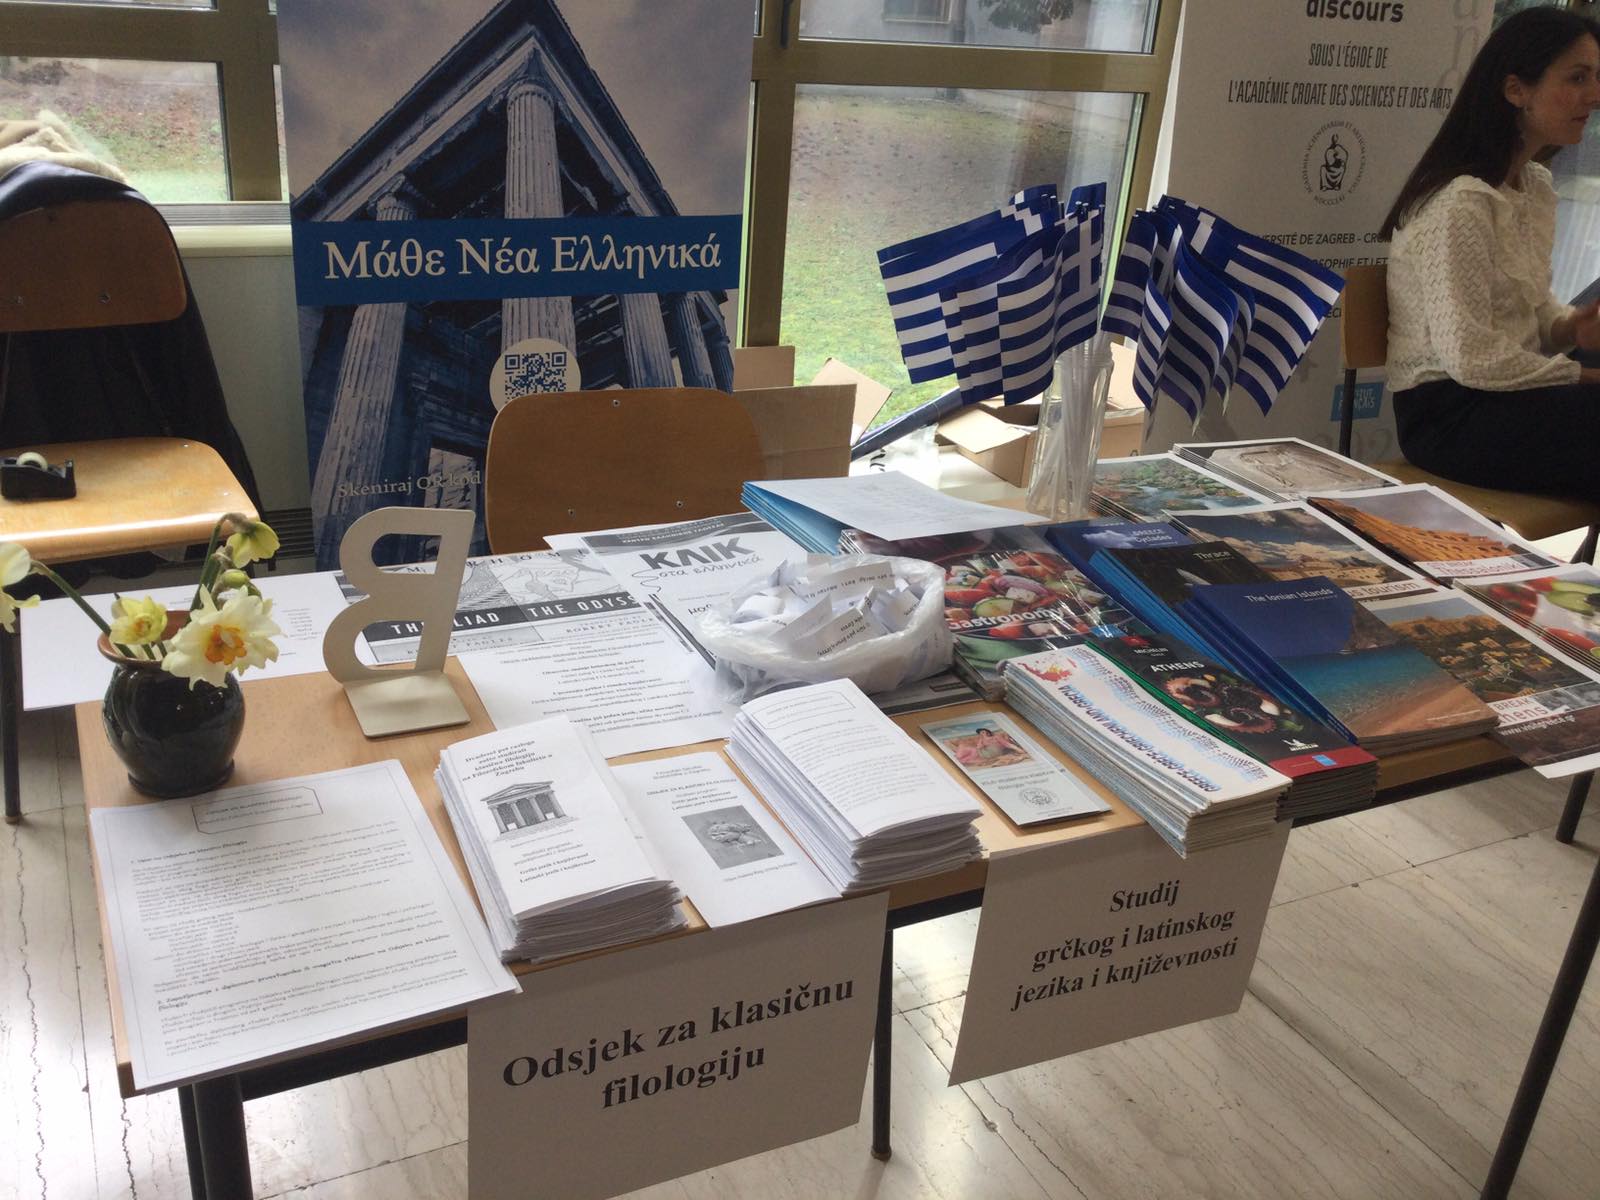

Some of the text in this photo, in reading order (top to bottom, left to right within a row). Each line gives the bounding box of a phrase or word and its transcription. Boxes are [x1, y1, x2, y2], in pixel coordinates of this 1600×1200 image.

[1306, 0, 1404, 22] discours
[1308, 40, 1389, 70] SOUS L'ÉGIDE DE
[1228, 76, 1453, 111] L'ACADÉMIE CROATE DES SCIENCES ET DES ARTS
[1299, 234, 1313, 246] DE
[1315, 233, 1356, 245] ZAGREB
[323, 232, 722, 280] Μάθε Νέα Ελληνικά
[338, 472, 413, 499] Skeniraj
[447, 470, 483, 489] kod
[1244, 593, 1266, 602] The
[1265, 591, 1297, 601] Ionian
[1296, 587, 1333, 598] Islands
[1364, 582, 1421, 595] tourism
[391, 611, 500, 635] TH LIAD
[527, 604, 569, 618] THE
[947, 606, 1068, 631] Gastronomy
[1150, 661, 1204, 673] ATHENS
[1495, 697, 1531, 710] BREAK
[1109, 879, 1180, 913] Studij
[1032, 909, 1235, 973] grčkog i latinskog
[1010, 936, 1239, 1012] jezika i književnosti
[503, 979, 854, 1087] Odsjek za klasičnu
[601, 1045, 766, 1109] filologiju
